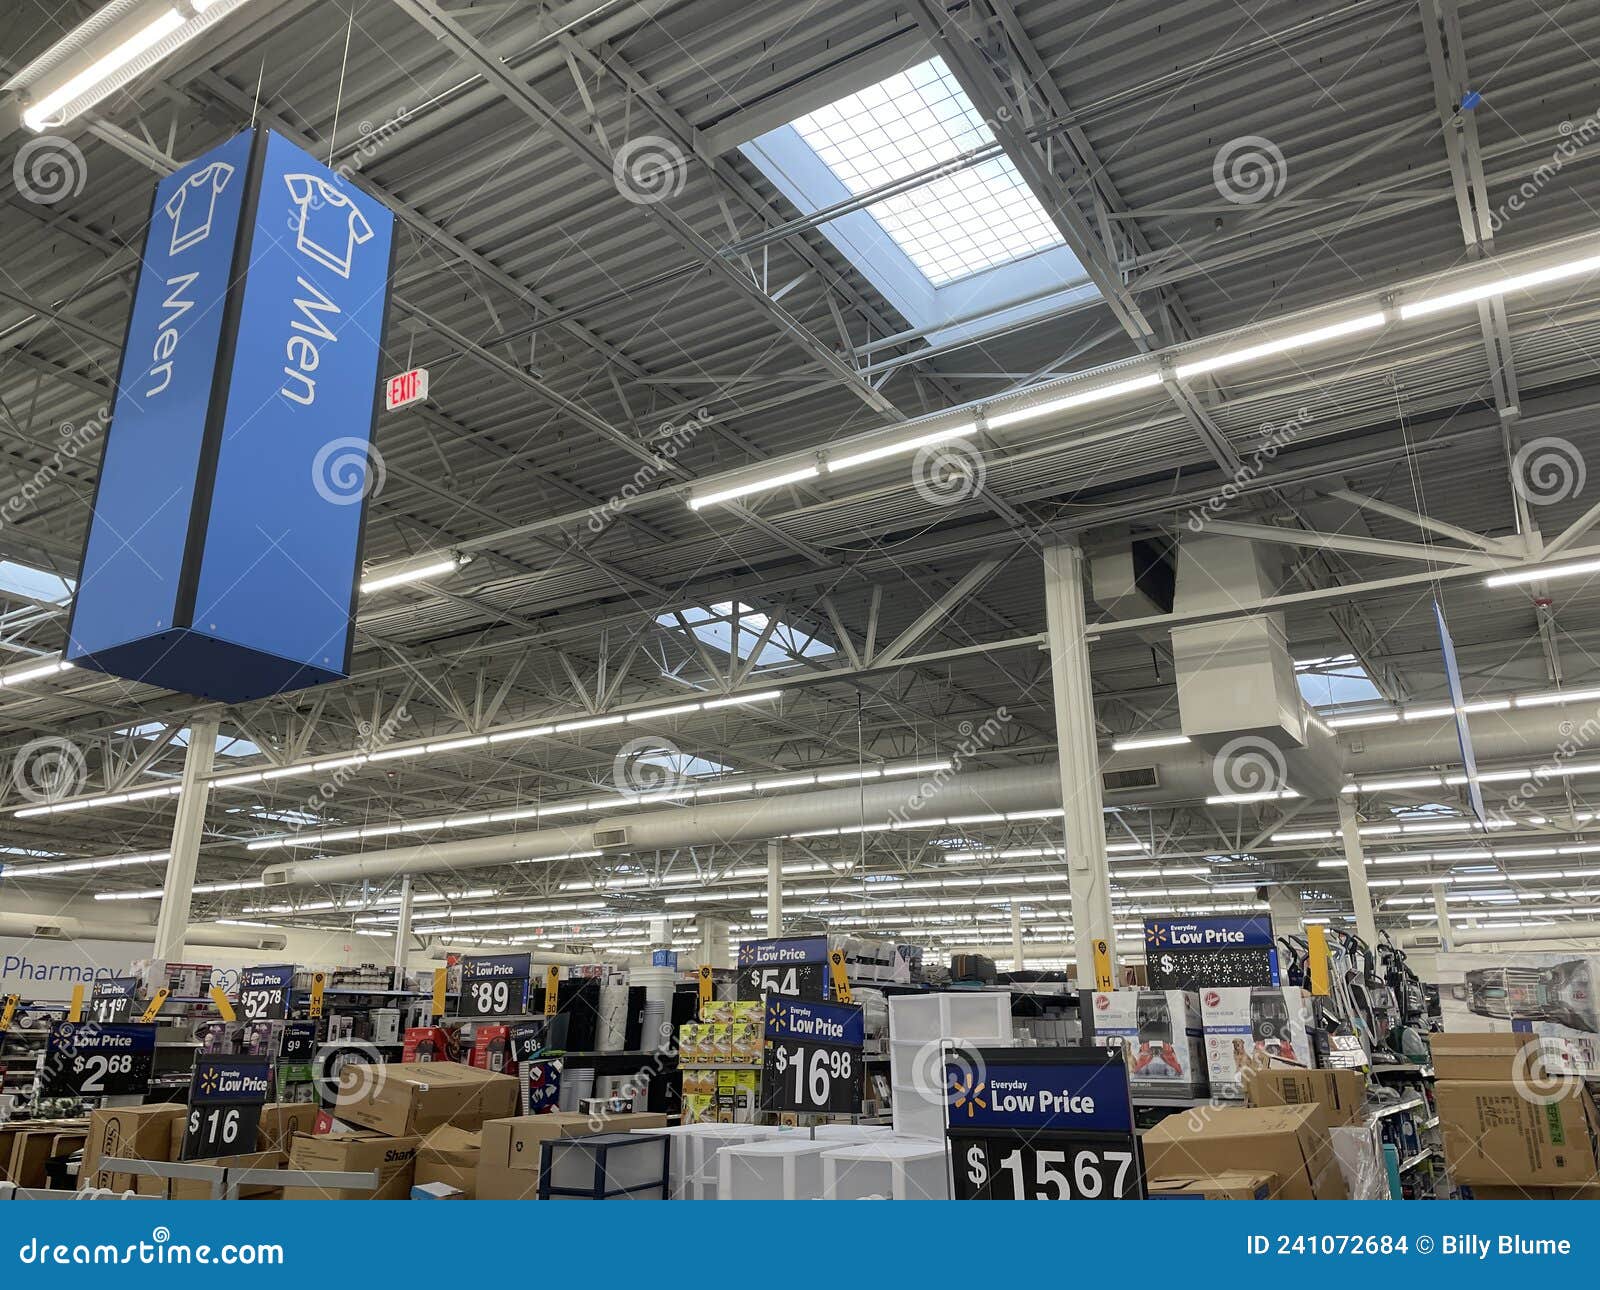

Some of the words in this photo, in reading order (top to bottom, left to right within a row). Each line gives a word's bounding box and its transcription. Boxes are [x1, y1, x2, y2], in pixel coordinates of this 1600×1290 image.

[146, 271, 200, 398] Men
[281, 276, 342, 405] Men
[392, 371, 418, 404] EXIT
[1171, 931, 1202, 945] Low
[1206, 929, 1244, 944] Price
[757, 951, 779, 962] Low
[780, 949, 806, 960] Price
[3, 956, 122, 981] Pharmacy
[476, 966, 492, 976] Low
[493, 965, 513, 975] Price
[1160, 954, 1174, 975] $
[250, 976, 264, 985] Low
[264, 975, 281, 985] Price
[1102, 976, 1111, 987] H
[837, 983, 847, 993] H
[471, 981, 508, 1013] $89
[790, 1006, 811, 1017] Everyday
[790, 1014, 813, 1034] Low
[816, 1016, 843, 1037] Price
[74, 1036, 100, 1047] Low
[102, 1034, 132, 1046] Price
[219, 1078, 242, 1092] Low
[243, 1077, 268, 1091] Price
[991, 1080, 1027, 1091] Everyday
[991, 1090, 1035, 1112] Low
[1039, 1090, 1095, 1113] Price
